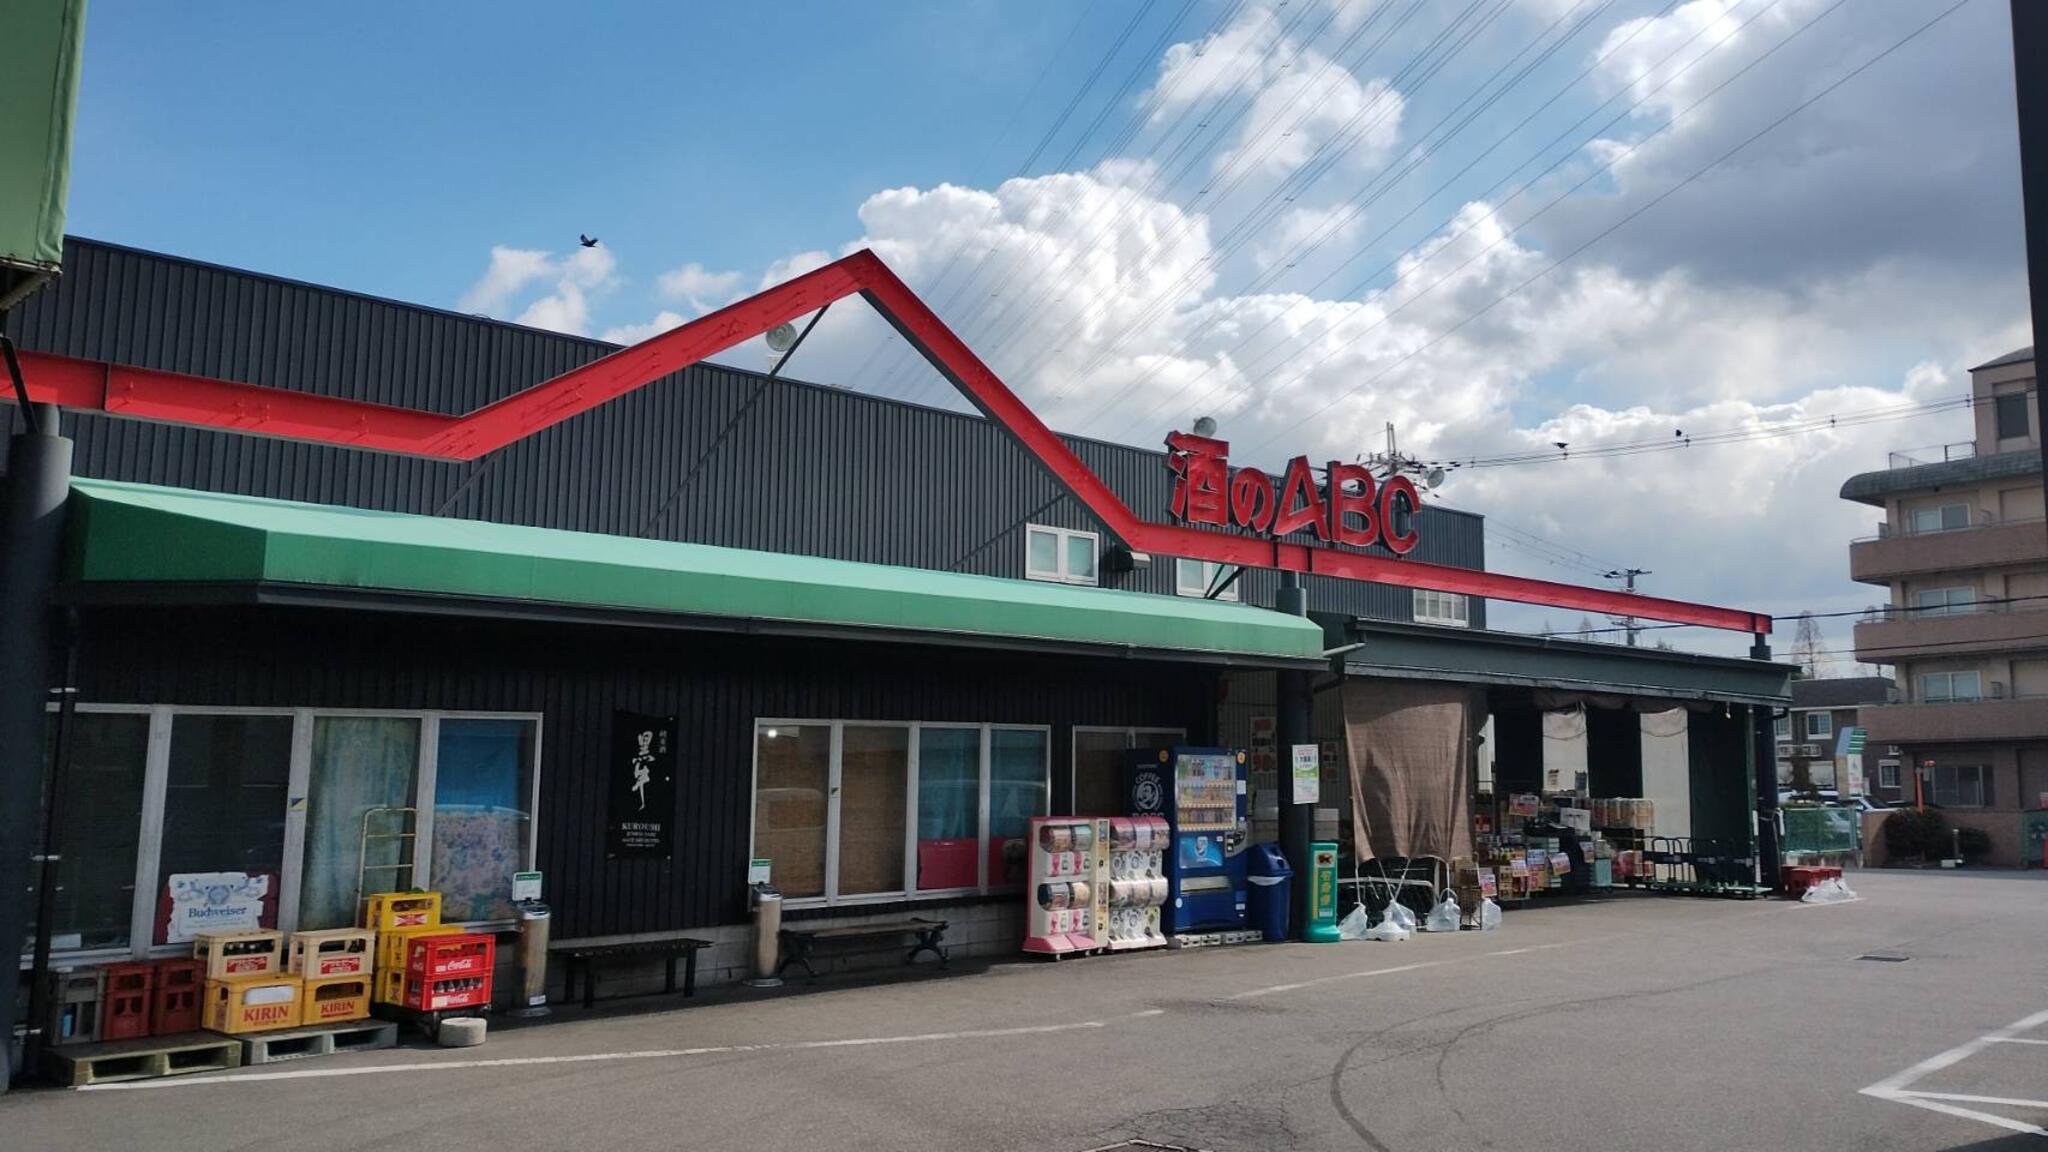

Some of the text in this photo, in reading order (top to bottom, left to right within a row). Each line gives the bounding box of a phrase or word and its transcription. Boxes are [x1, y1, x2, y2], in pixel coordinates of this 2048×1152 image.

[1165, 431, 1421, 554] 酒のABC
[632, 731, 655, 811] 黒牛
[188, 905, 247, 918] Budweiser
[243, 1005, 289, 1022] KIRIN
[319, 1000, 355, 1014] KIRIN
